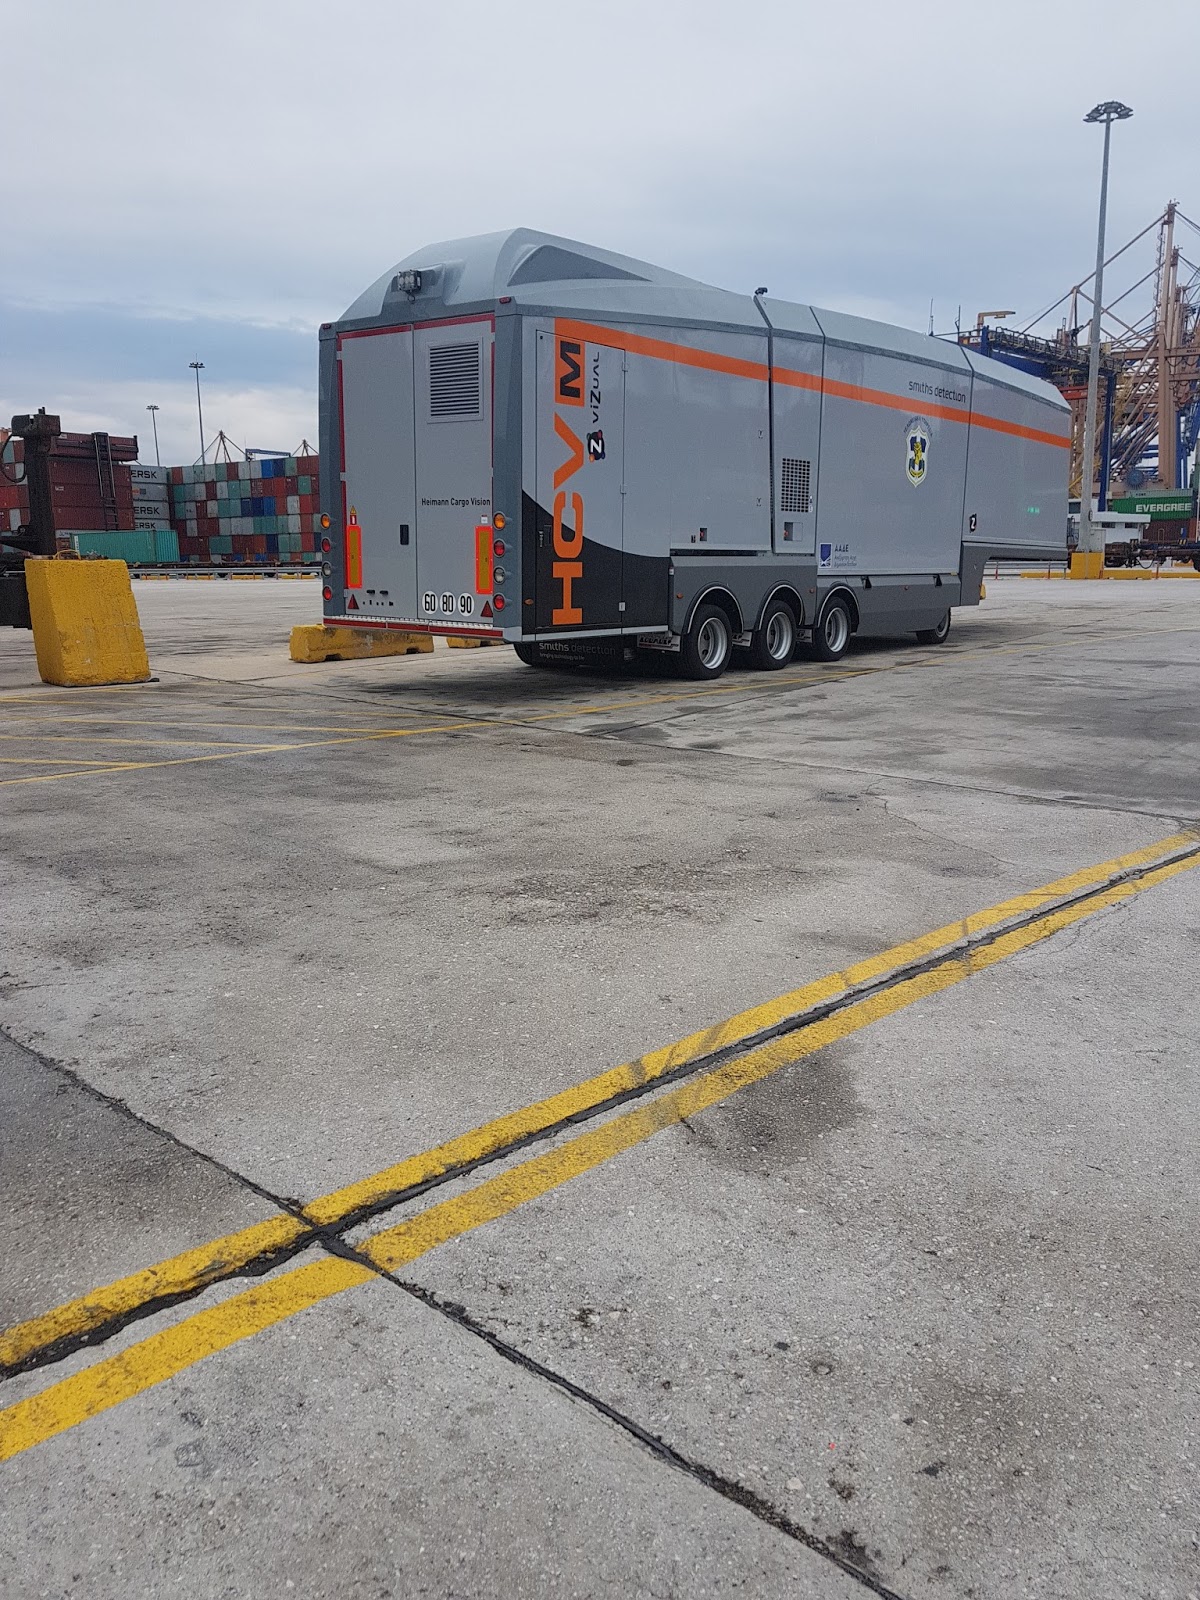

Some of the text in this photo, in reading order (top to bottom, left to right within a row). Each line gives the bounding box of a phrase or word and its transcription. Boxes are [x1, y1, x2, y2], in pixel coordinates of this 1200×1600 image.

[908, 380, 967, 404] smiths detection
[421, 497, 491, 508] Heimann Cargo Vision
[424, 593, 436, 612] 60
[442, 594, 454, 613] 80
[460, 595, 472, 614] 90
[538, 642, 570, 652] smiths
[571, 644, 616, 656] detection
